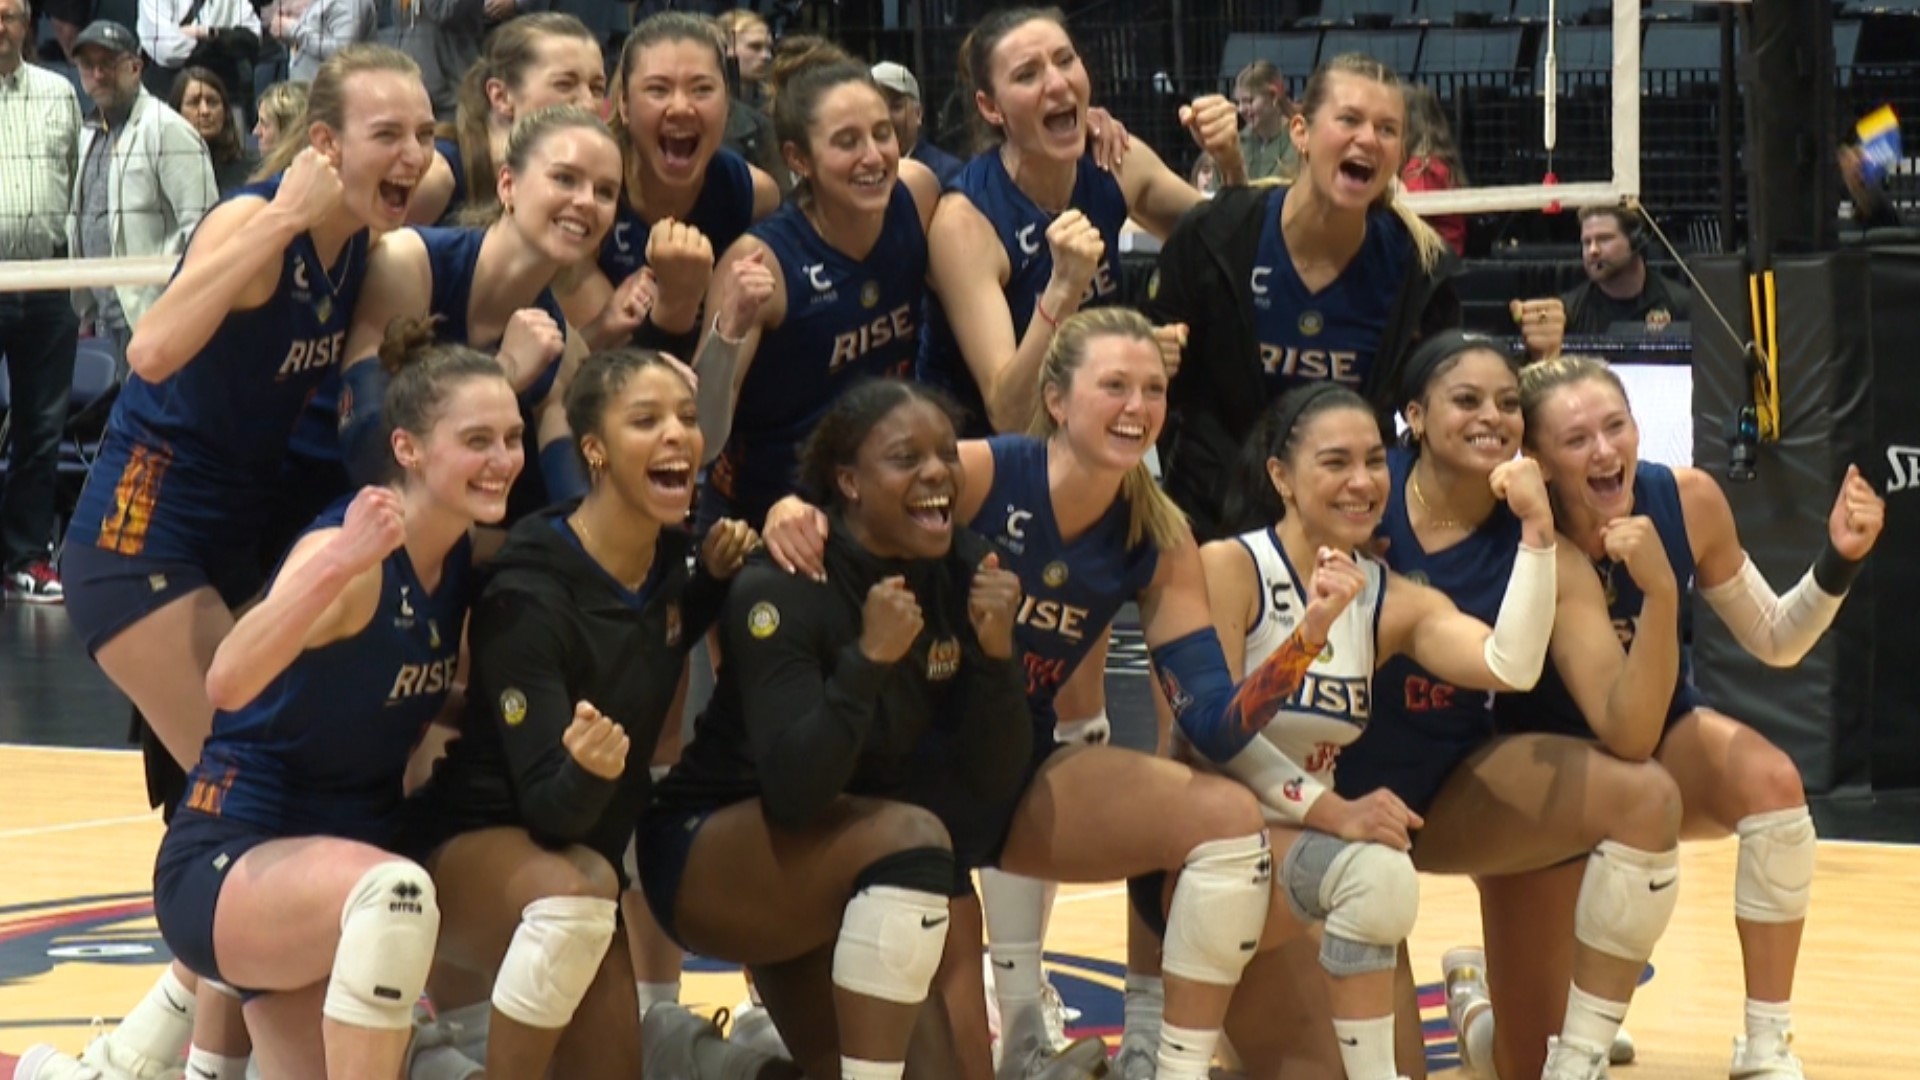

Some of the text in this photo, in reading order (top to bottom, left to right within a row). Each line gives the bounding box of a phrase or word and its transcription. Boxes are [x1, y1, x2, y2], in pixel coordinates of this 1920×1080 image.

[831, 303, 914, 368] RISE
[1259, 342, 1361, 382] RISE
[1016, 594, 1090, 638] ISE
[389, 901, 422, 916] errea
